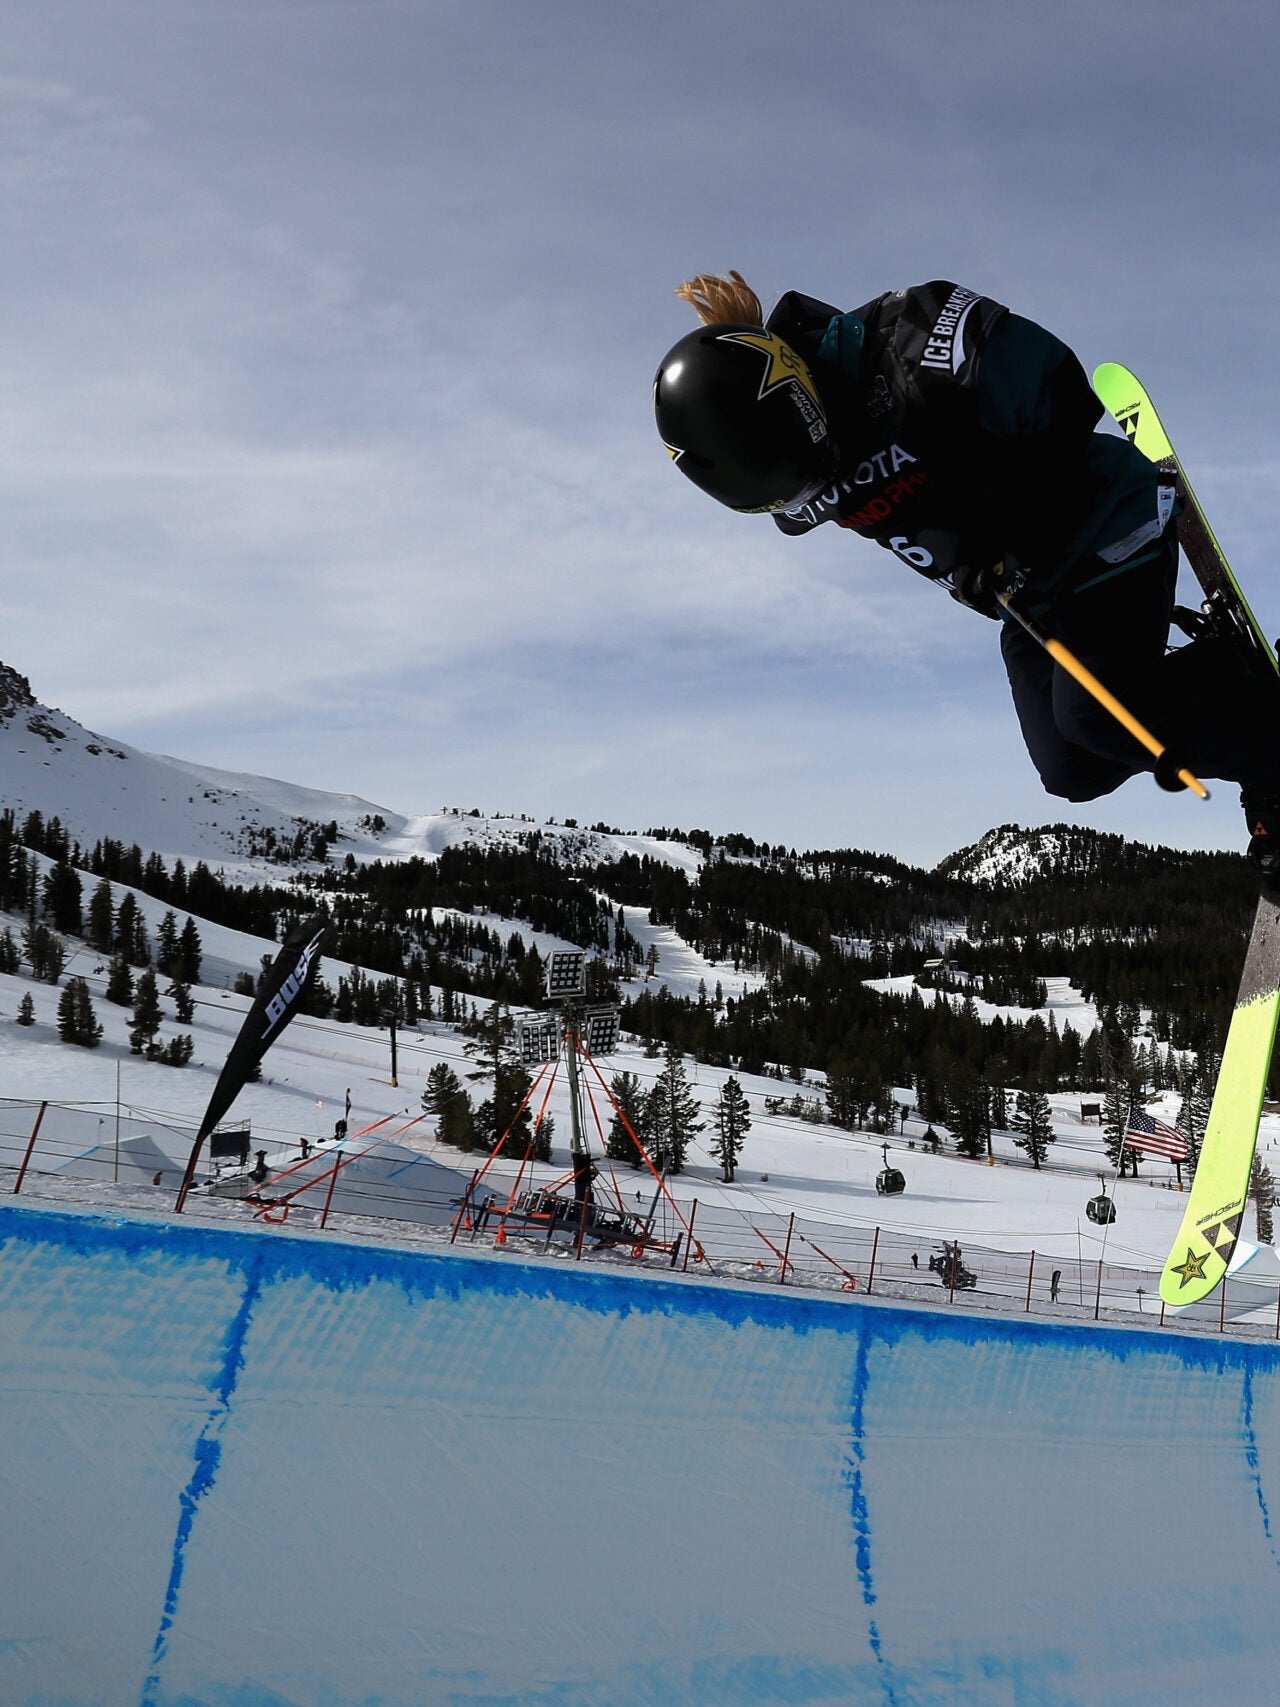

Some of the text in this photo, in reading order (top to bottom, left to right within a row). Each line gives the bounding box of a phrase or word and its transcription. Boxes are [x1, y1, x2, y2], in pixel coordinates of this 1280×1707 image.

[920, 336, 951, 370] ICE
[889, 536, 934, 568] 6
[1195, 1198, 1242, 1227] FISCHER
